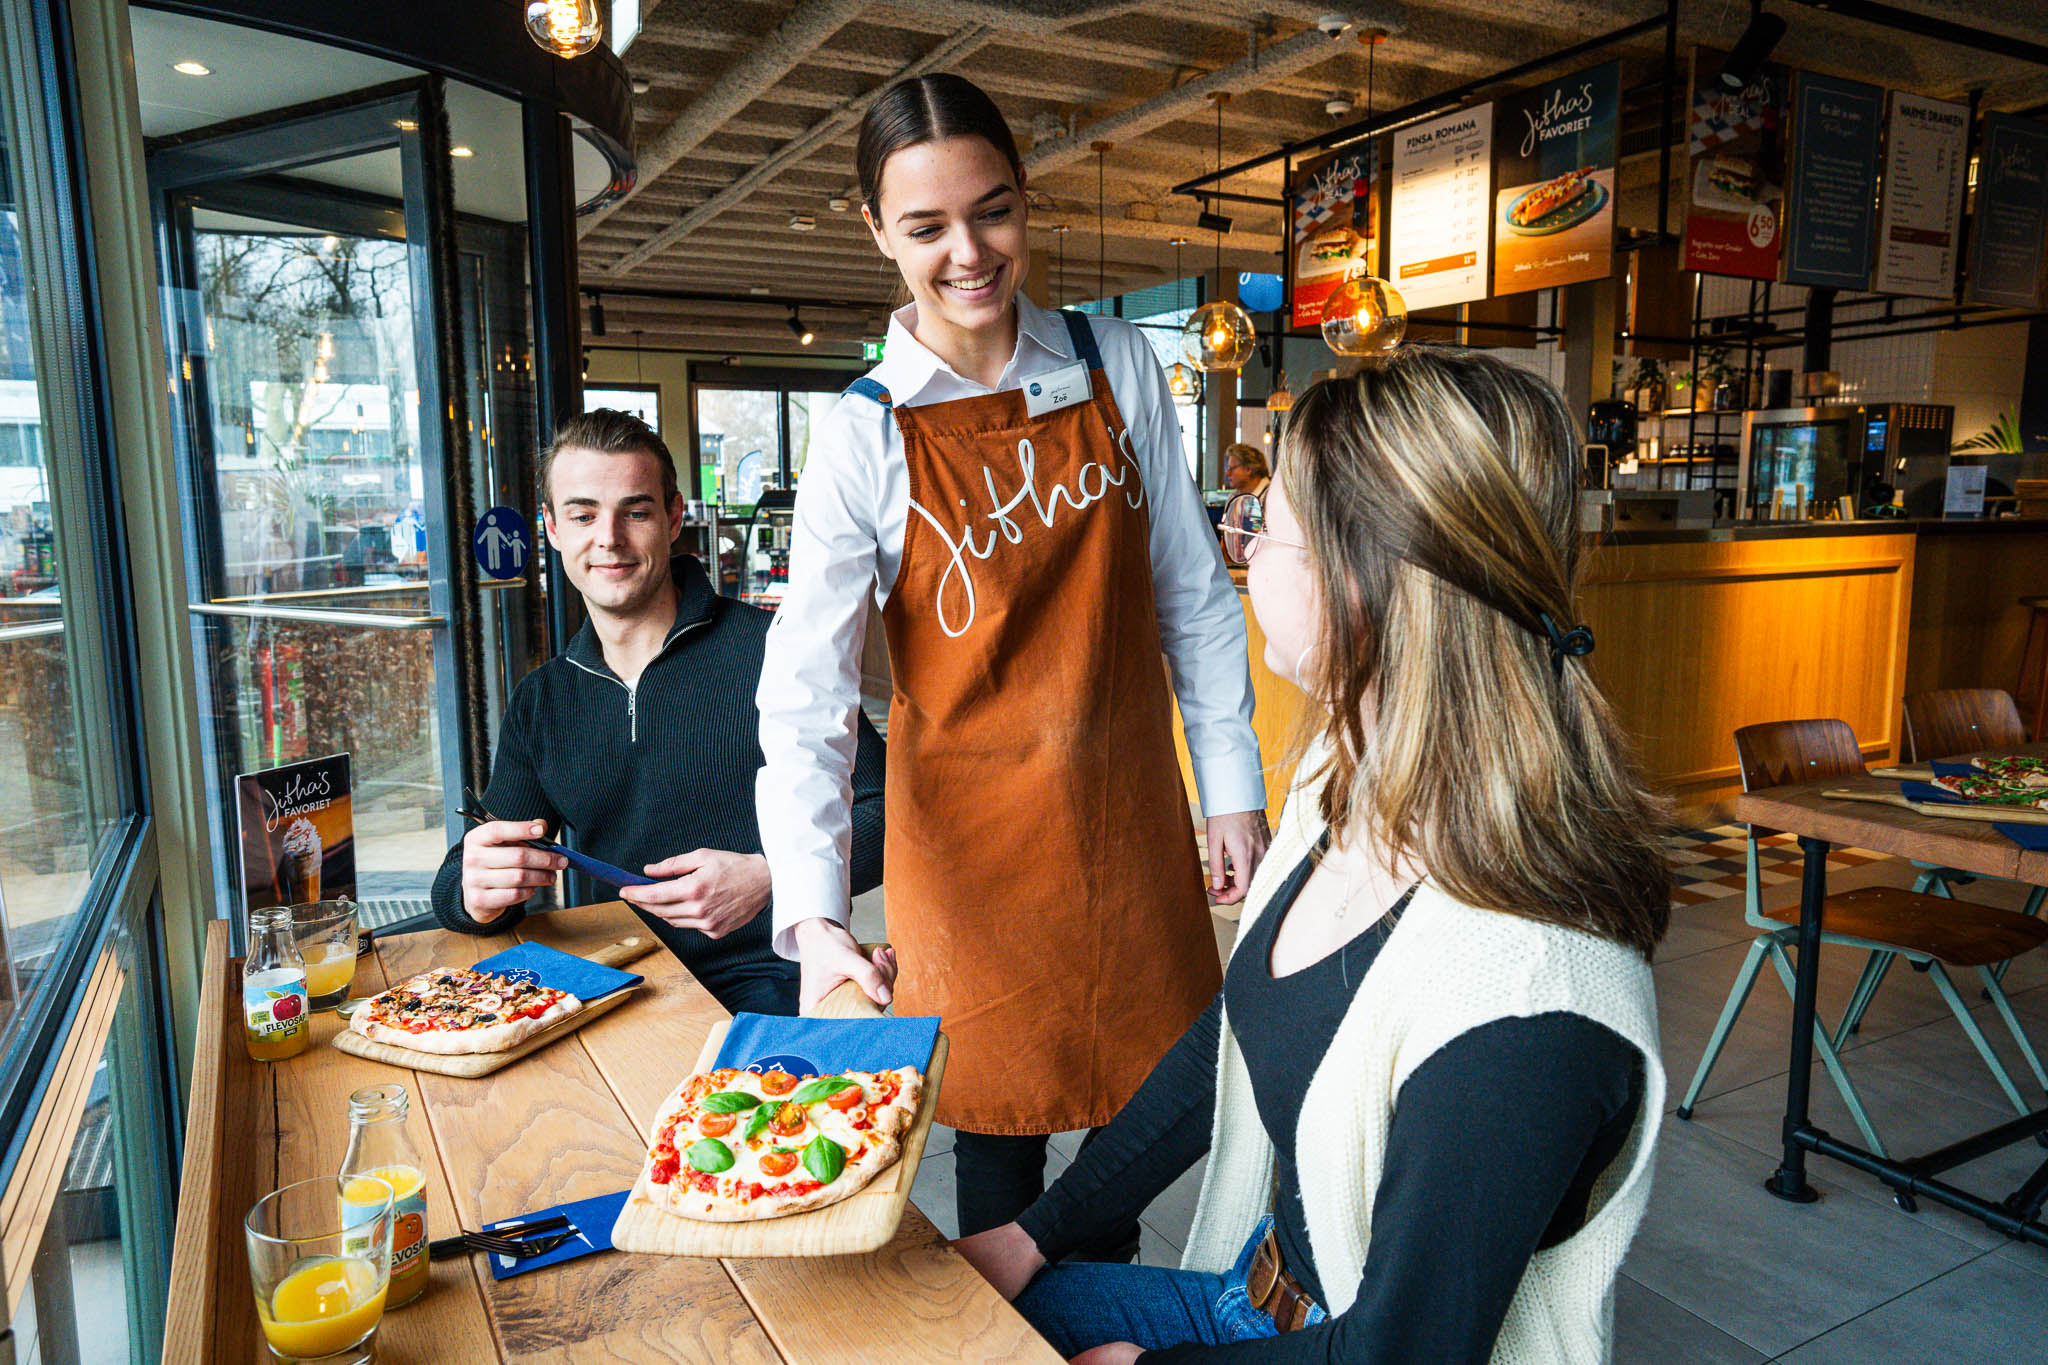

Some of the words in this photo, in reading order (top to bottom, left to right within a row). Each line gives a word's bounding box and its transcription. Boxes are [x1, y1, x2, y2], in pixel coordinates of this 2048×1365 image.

[1406, 133, 1433, 149] PINSA
[1435, 119, 1476, 140] ROMANA
[1539, 115, 1592, 143] FAVORIET
[1053, 393, 1067, 404] Zoë
[909, 426, 1145, 638] Jitha's
[264, 771, 331, 833] Jitha's
[284, 798, 332, 819] FAVORIET
